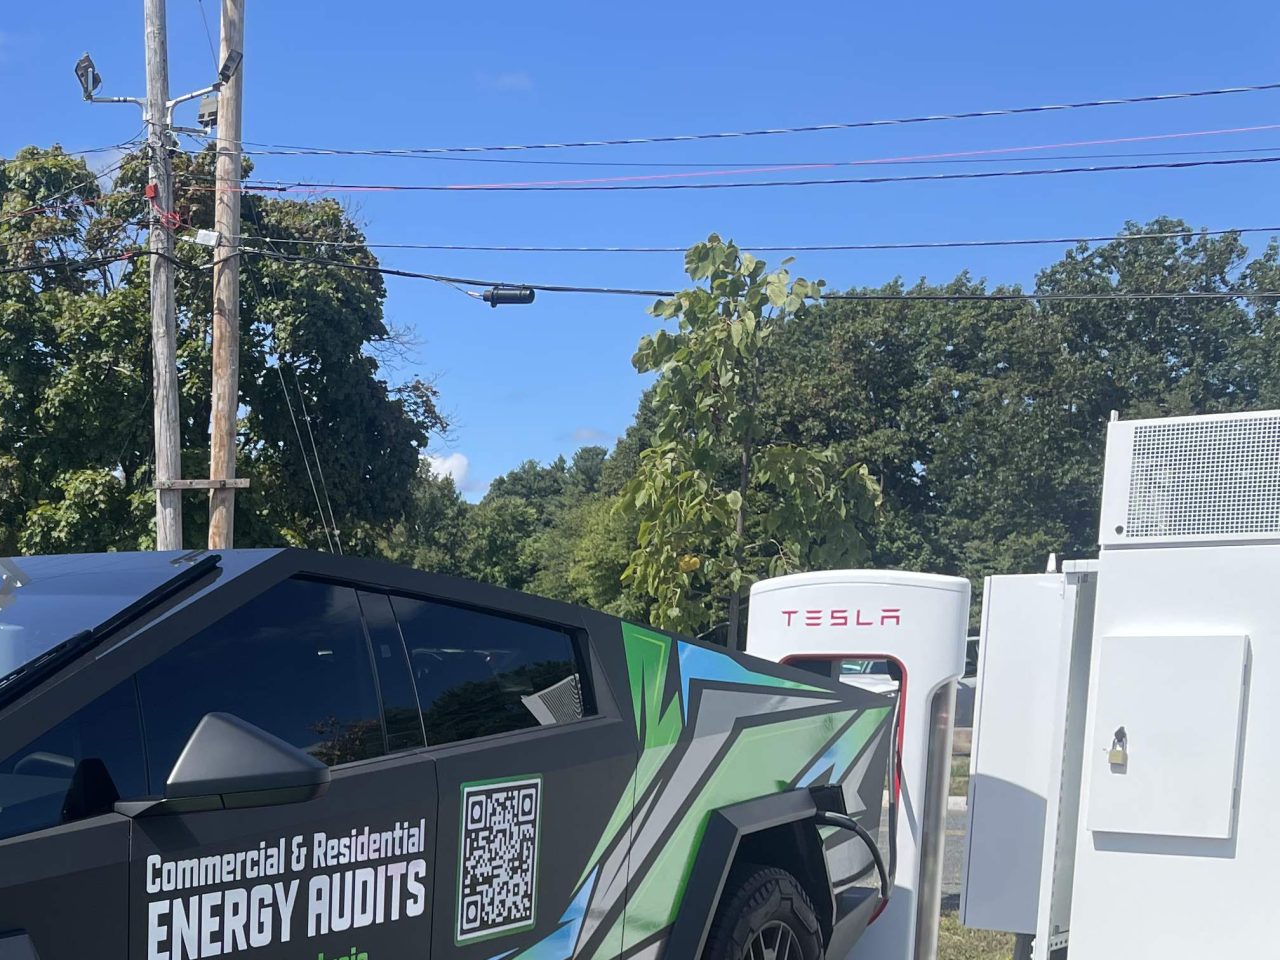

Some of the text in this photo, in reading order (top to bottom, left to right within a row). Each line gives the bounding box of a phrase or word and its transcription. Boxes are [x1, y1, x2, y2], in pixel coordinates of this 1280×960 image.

[781, 608, 901, 627] TESLA
[146, 818, 426, 894] Commercial & Residential
[307, 859, 427, 938] AUDITS
